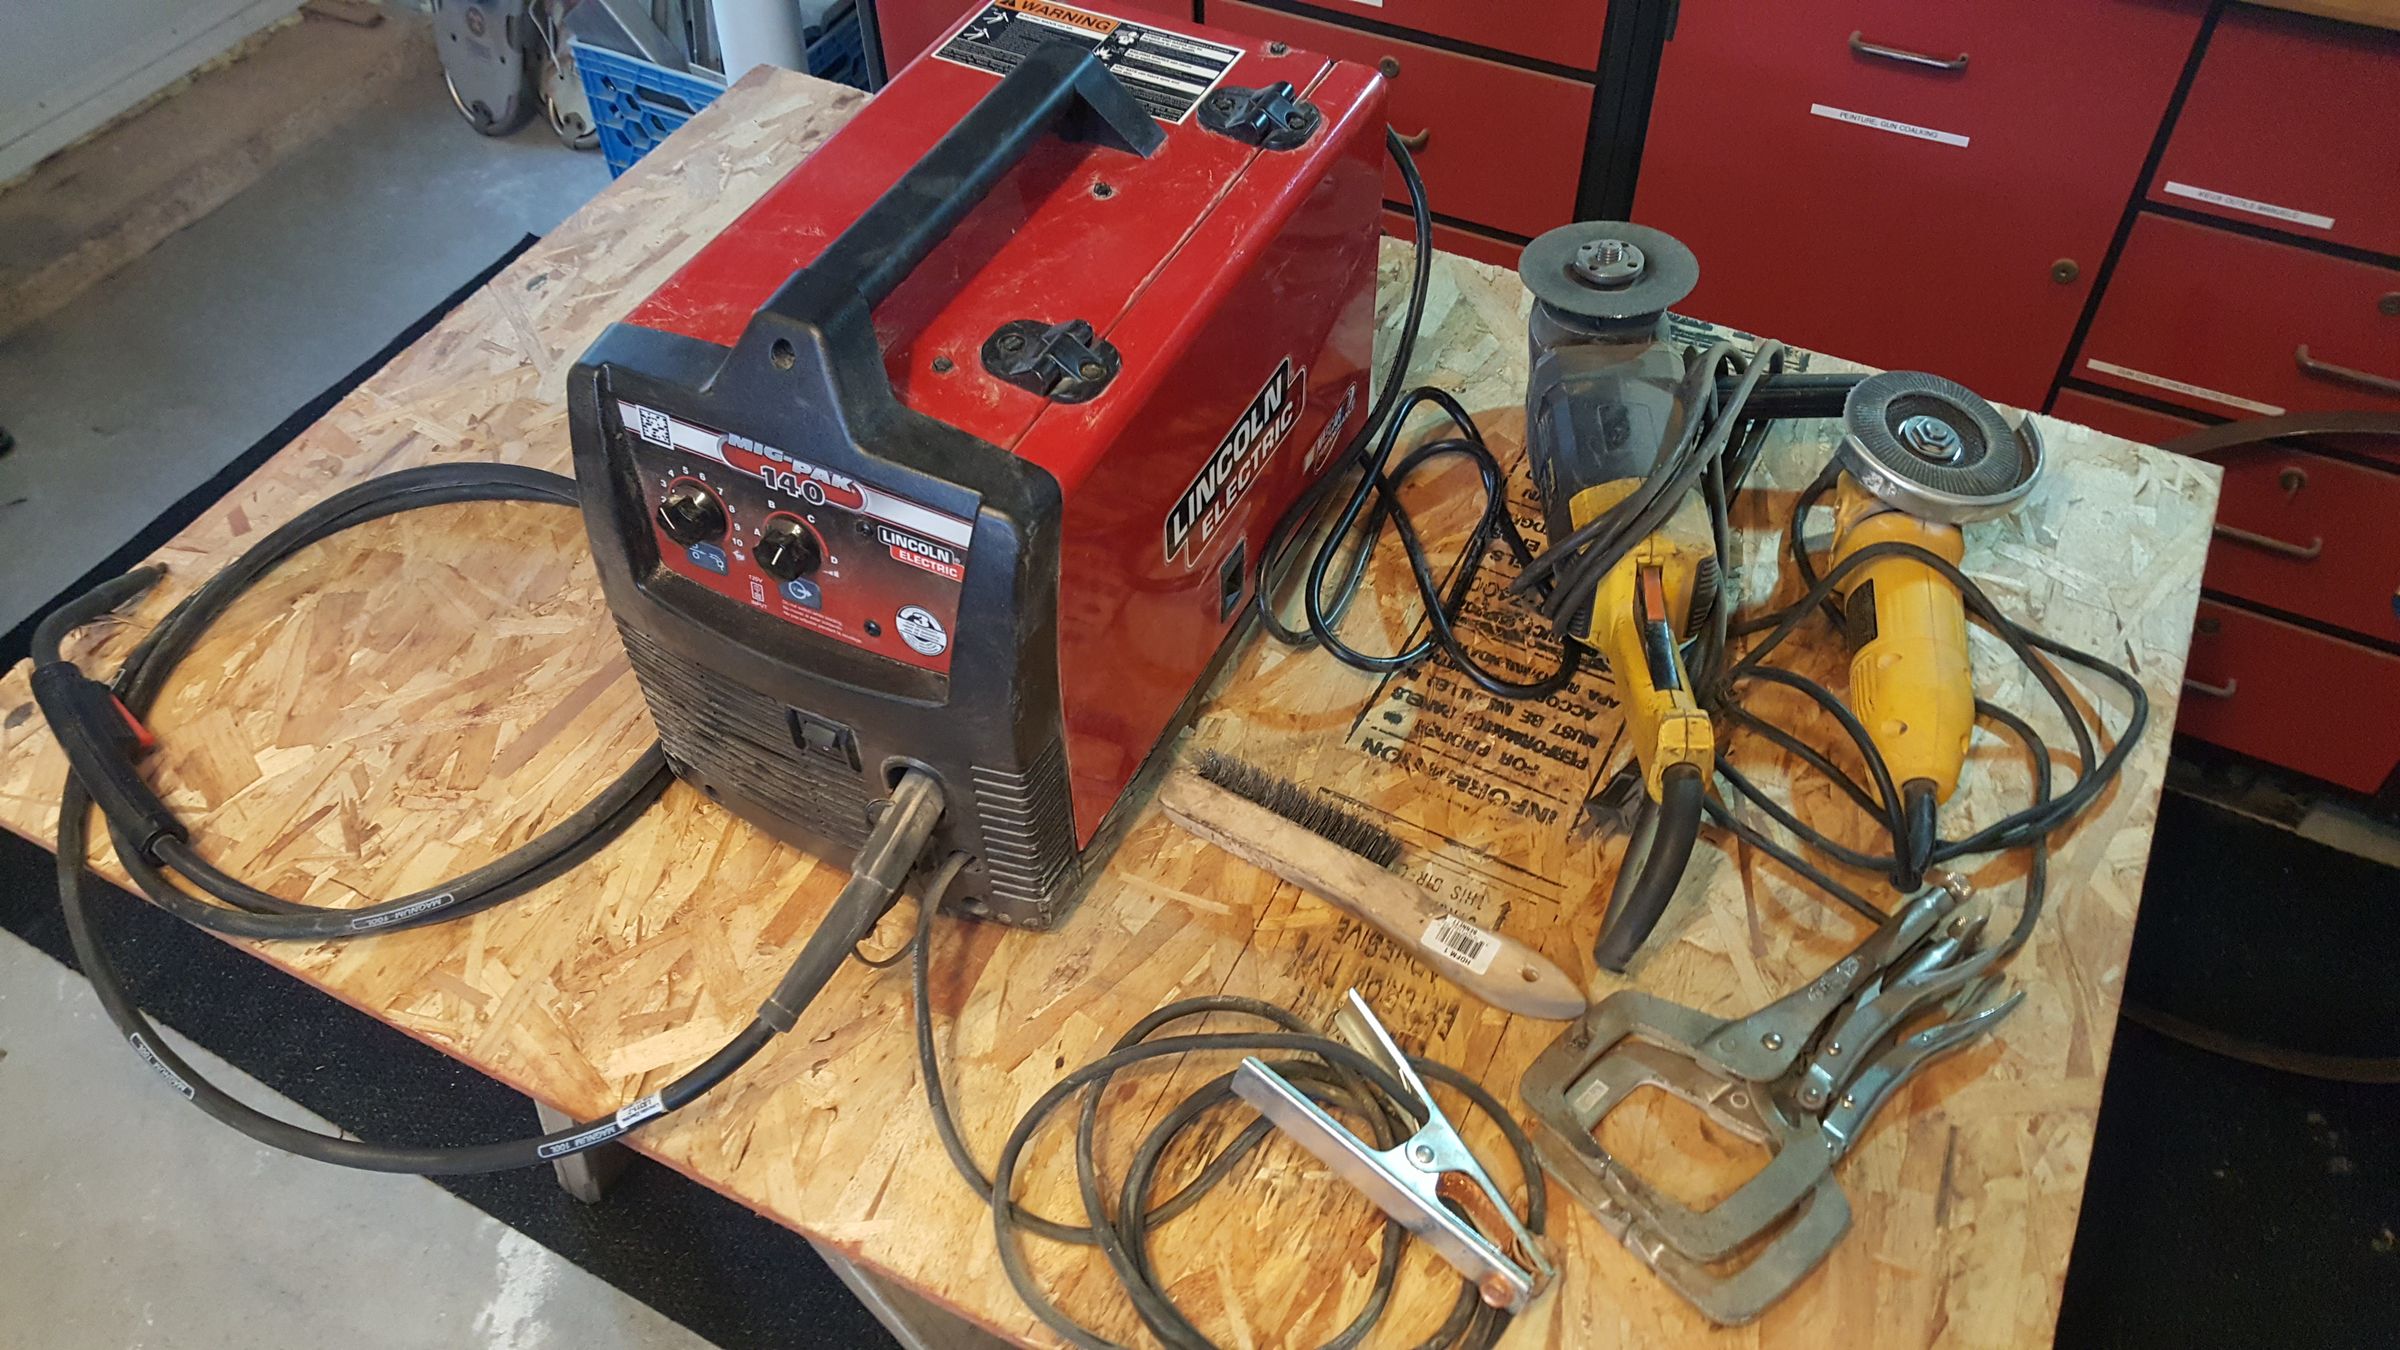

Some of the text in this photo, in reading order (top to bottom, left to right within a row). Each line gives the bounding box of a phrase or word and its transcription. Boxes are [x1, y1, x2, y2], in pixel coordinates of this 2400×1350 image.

[1021, 1, 1111, 31] WARNING
[728, 432, 853, 493] MIG-PAK
[1173, 373, 1283, 547] LINCOLN
[1202, 401, 1294, 542] ELECTRIC
[668, 469, 675, 478] 4
[760, 465, 825, 506] 140
[716, 487, 724, 496] 7
[768, 500, 776, 509] B
[807, 514, 816, 524] C
[732, 537, 743, 547] 10
[754, 527, 761, 537] A
[881, 530, 951, 564] LINCOLN
[830, 555, 839, 566] D
[898, 550, 959, 578] ELECTRIC
[1585, 687, 1621, 710] APA
[1389, 683, 1590, 771] PERFORMANCE PANELS
[1518, 708, 1545, 729] BE
[1549, 719, 1600, 749] MUST
[1497, 750, 1540, 777] FOR
[1357, 735, 1560, 827] INFORMATION
[394, 898, 441, 918] MAGNUM
[574, 1125, 615, 1146] MAGNUM
